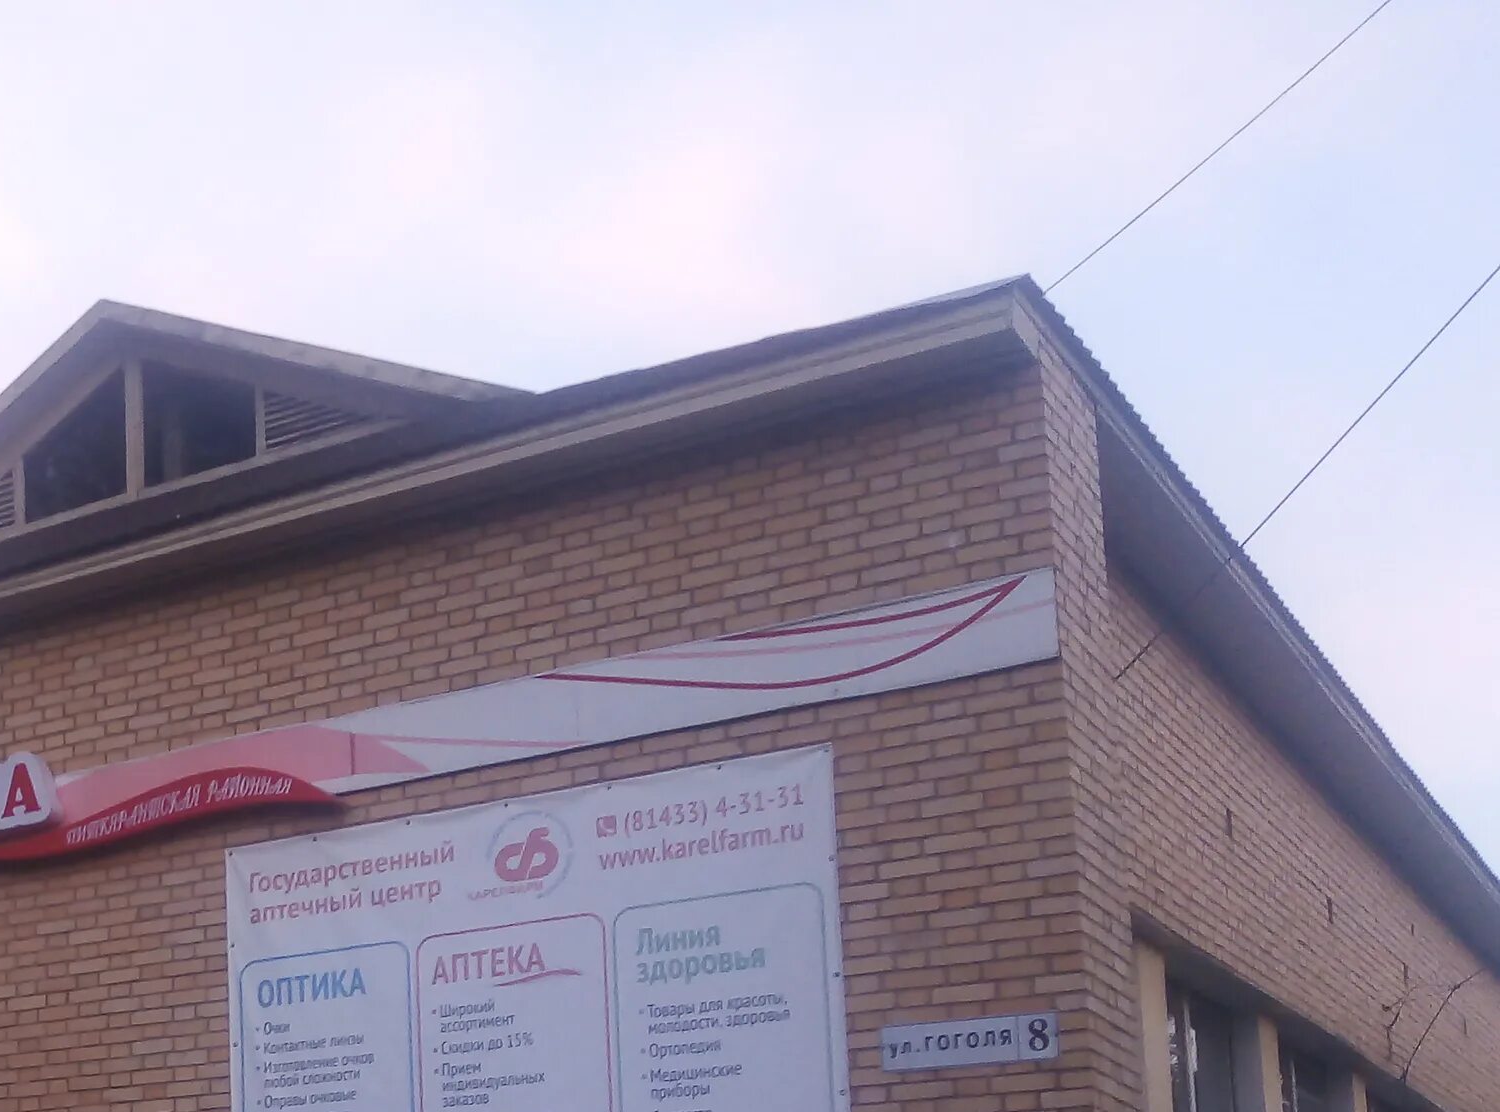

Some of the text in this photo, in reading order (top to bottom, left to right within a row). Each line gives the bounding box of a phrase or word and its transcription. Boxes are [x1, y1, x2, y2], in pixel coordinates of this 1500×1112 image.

[206, 772, 293, 804] РАЙОННАЯ
[624, 783, 804, 838] (81433) 4-31-31
[598, 822, 805, 871] www.karelfarm.ru
[249, 839, 455, 895] Государственный
[250, 878, 442, 925] аптечный центр
[636, 925, 721, 956] Линия
[431, 942, 546, 985] АПТЕКА
[636, 947, 766, 986] здоровья
[257, 967, 367, 1009] ОПТИКА
[439, 998, 496, 1018] Широкий
[647, 1002, 695, 1019] Товары
[698, 999, 724, 1015] для
[725, 1009, 791, 1027] здоровья
[263, 1021, 291, 1036] Очки
[440, 1013, 516, 1033] ассортимент
[263, 1033, 365, 1054] Контактные линзы
[440, 1031, 535, 1055] Скидки до 15%
[1027, 1017, 1051, 1053] 8
[648, 1038, 722, 1060] Ортопедия
[302, 1068, 362, 1086] сложности
[441, 1061, 482, 1079] Прием
[649, 1063, 743, 1084] Медицинские
[442, 1071, 546, 1092] индивидуальных
[650, 1082, 711, 1102] приборы
[264, 1089, 357, 1110] Оправы очковые
[442, 1092, 490, 1109] заказов
